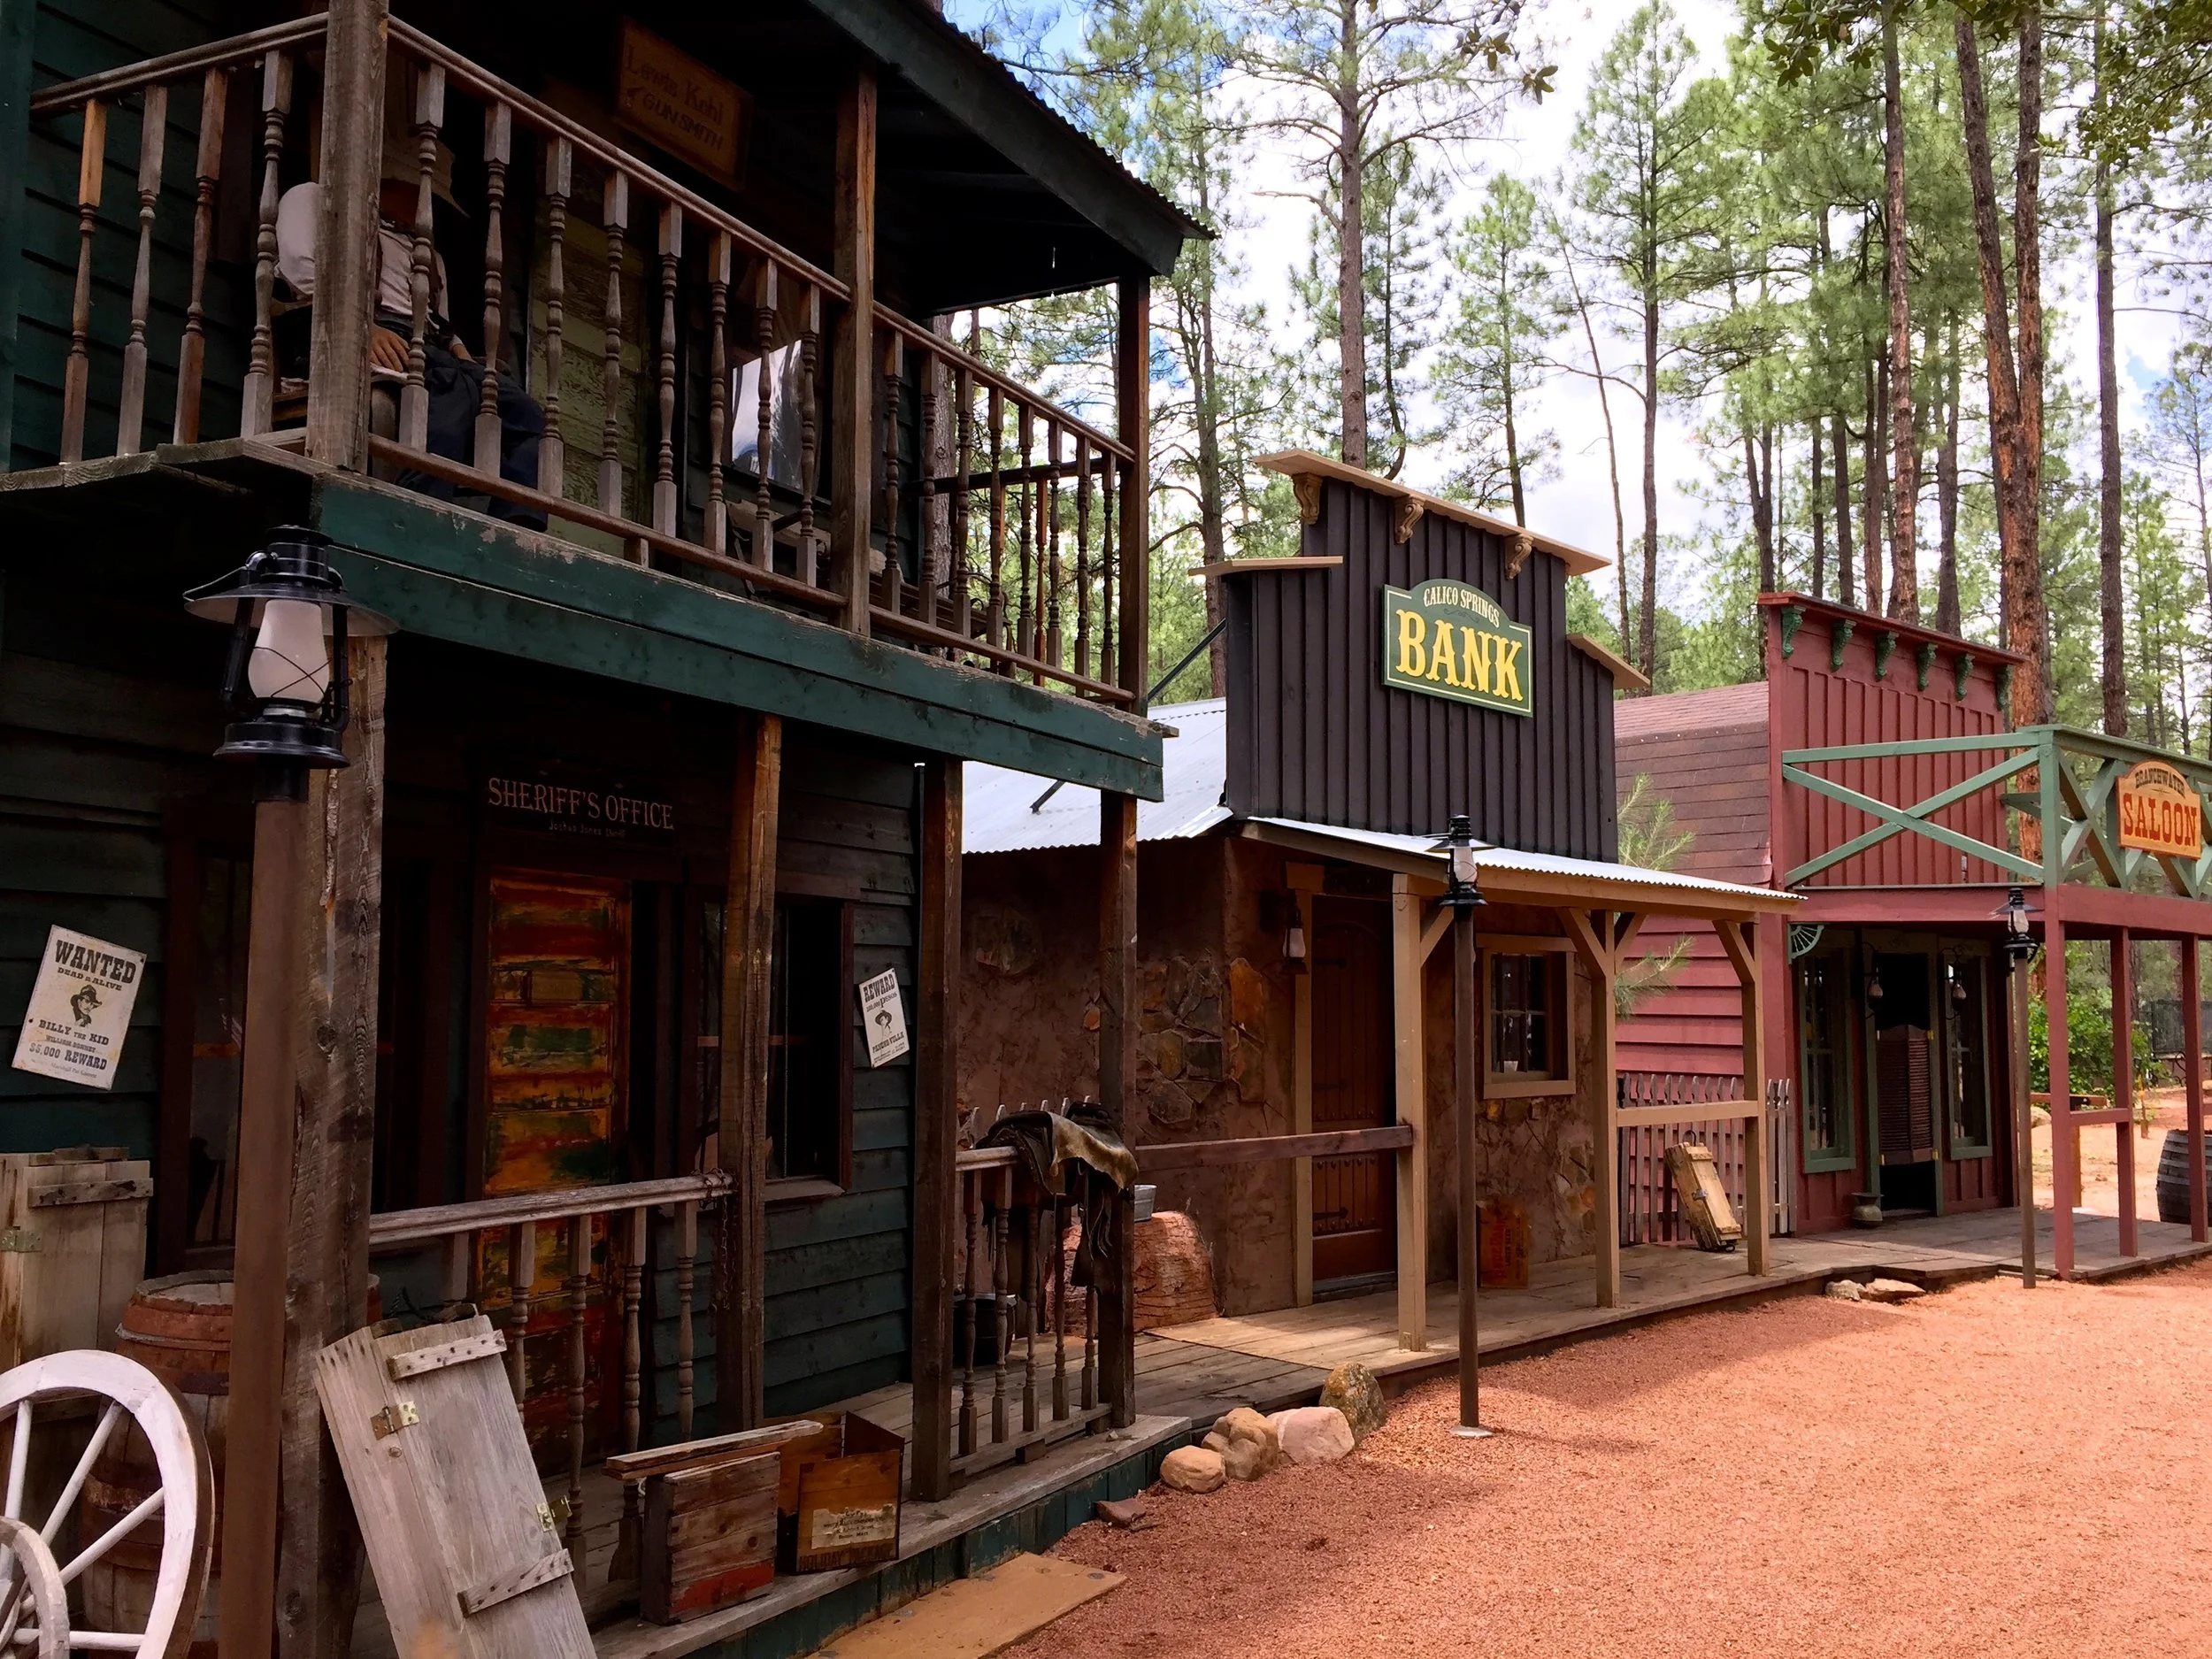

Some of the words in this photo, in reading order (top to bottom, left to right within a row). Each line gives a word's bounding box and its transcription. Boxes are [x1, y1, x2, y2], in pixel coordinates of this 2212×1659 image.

[642, 92, 724, 152] GUNSMITH
[1423, 585, 1459, 607] CALICO
[1459, 588, 1500, 628] SPRINGS
[1395, 609, 1524, 702] BANK
[488, 777, 601, 819] SHERIFF'S
[604, 795, 675, 831] OFFICE
[2123, 792, 2198, 847] SALOON
[54, 939, 136, 984] WANTED
[57, 966, 85, 980] DEAD
[91, 978, 123, 992] ALIVE
[863, 973, 895, 1003] REWARD
[38, 1019, 73, 1035] BILLY
[73, 1031, 87, 1041] THE
[88, 1033, 110, 1046] KID
[28, 1041, 61, 1059] $5,000
[64, 1049, 108, 1071] REWARD
